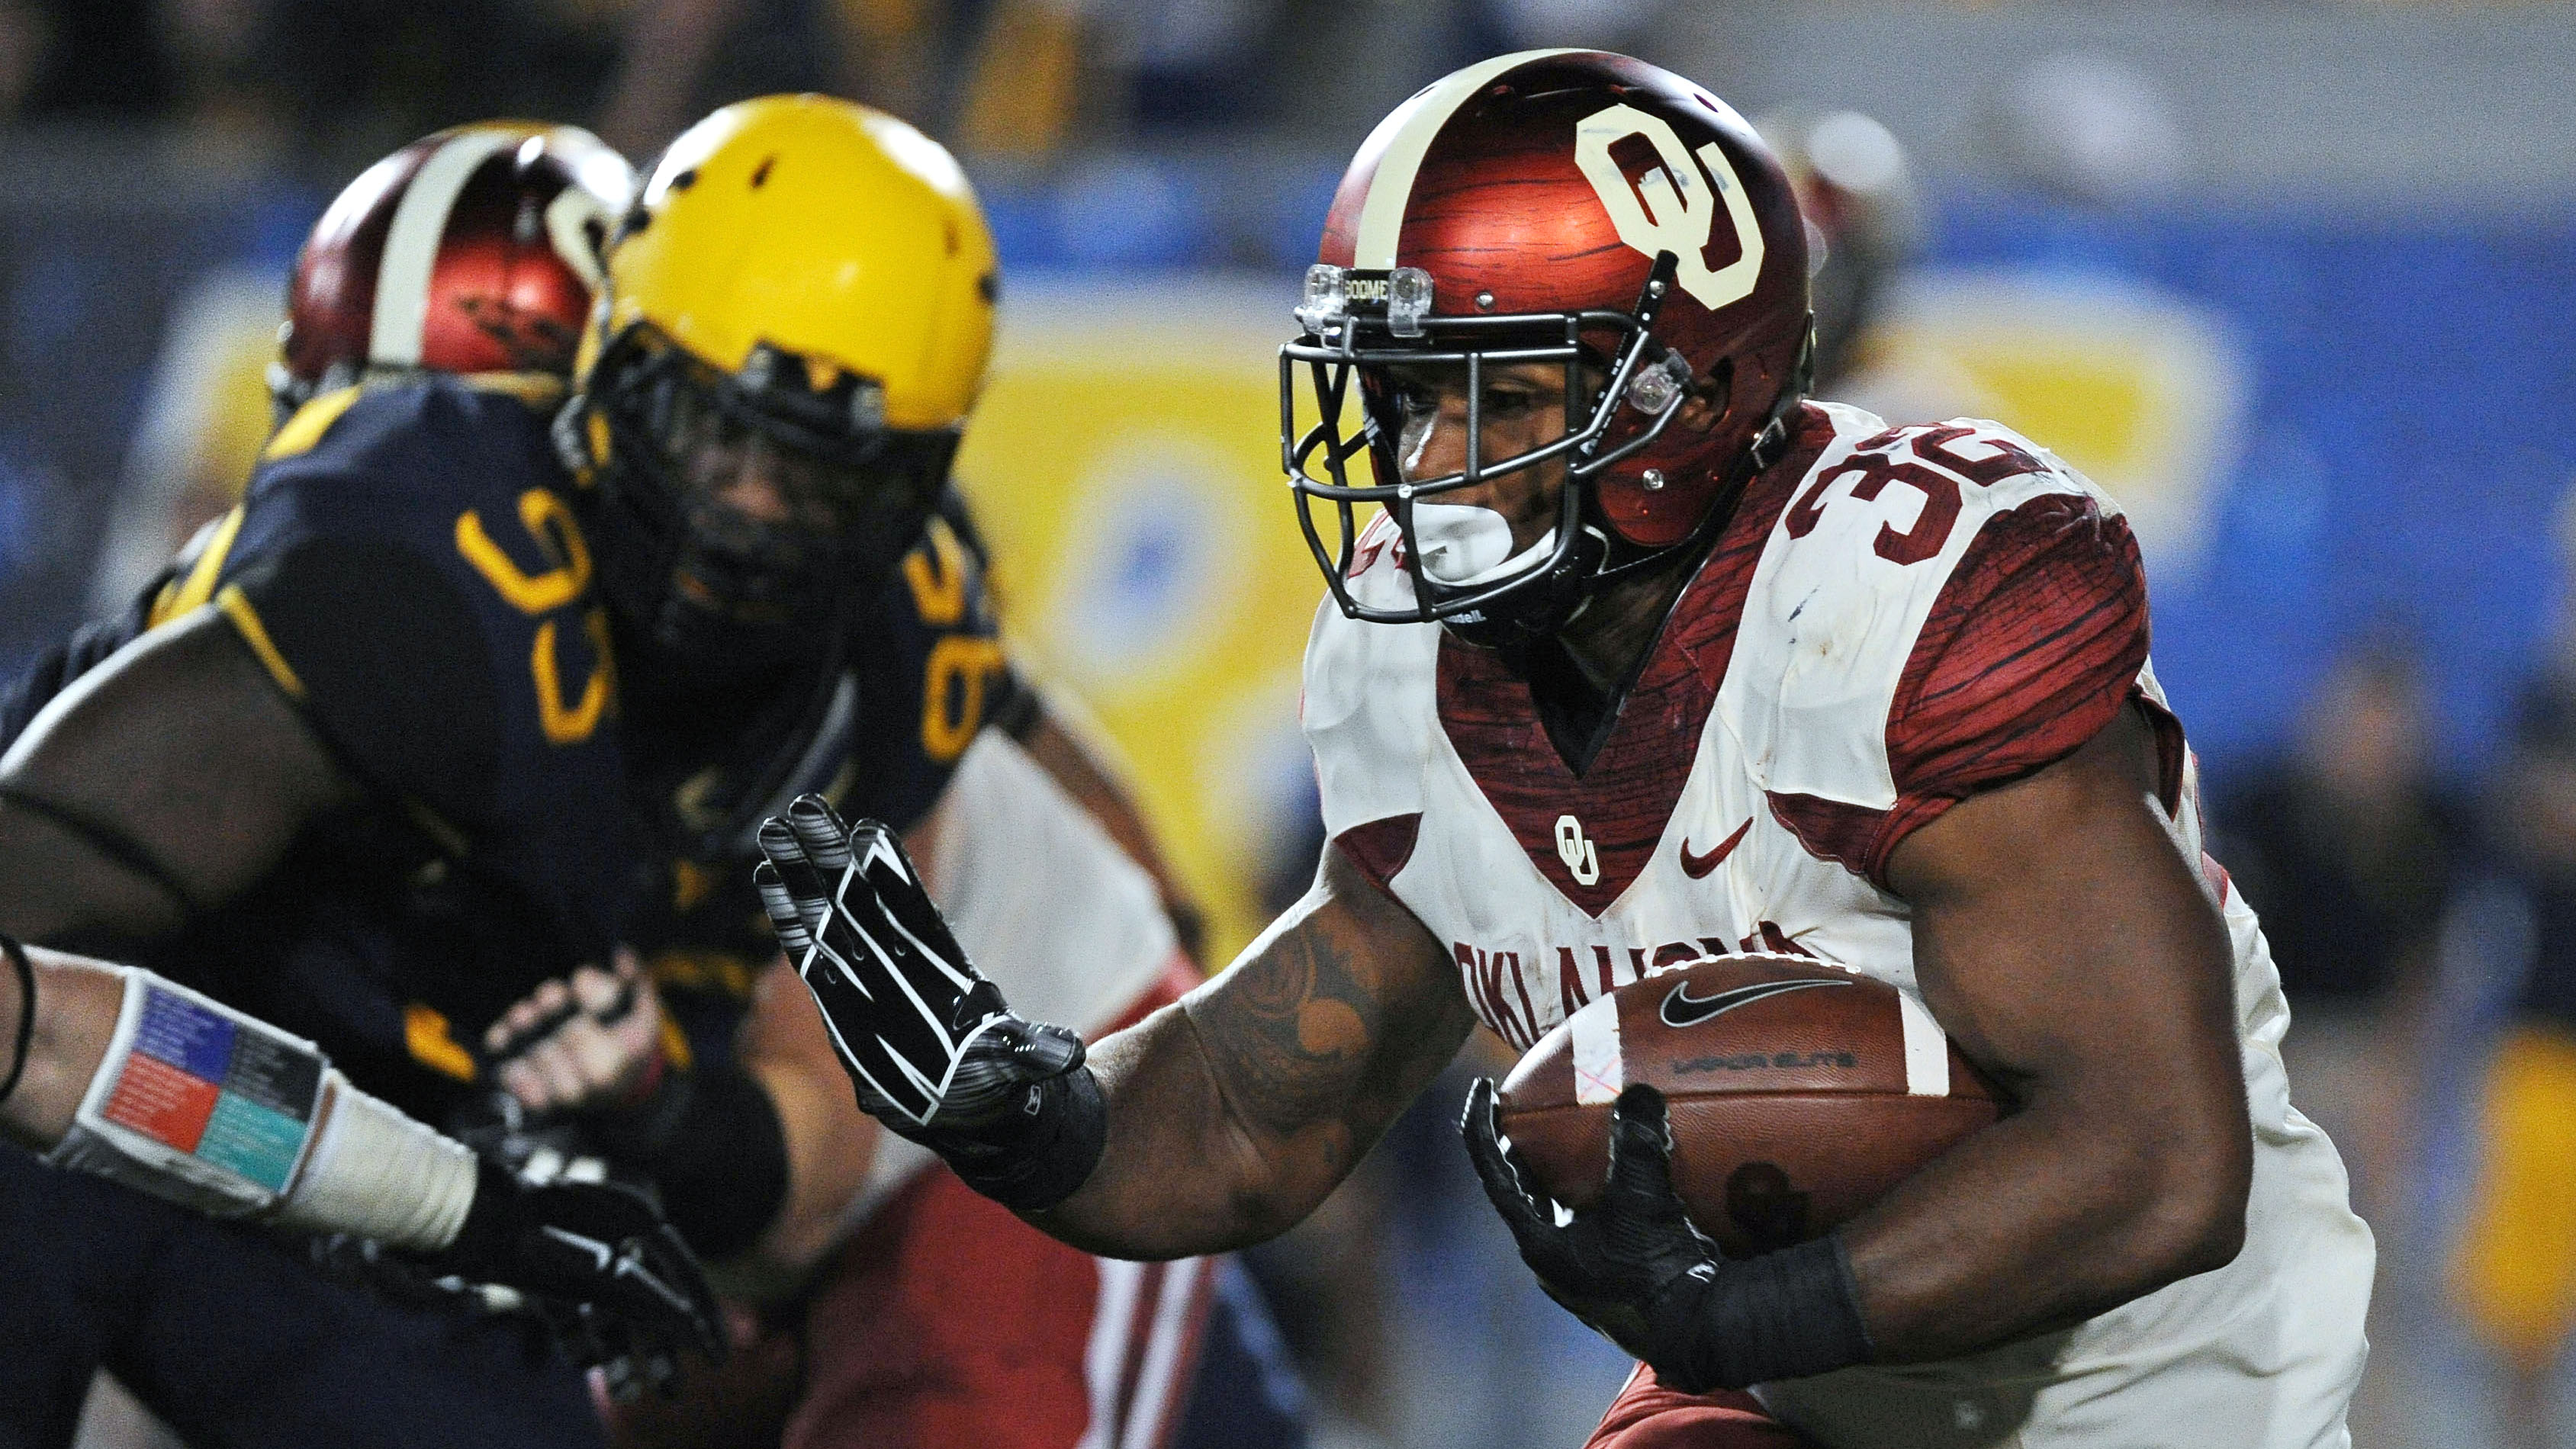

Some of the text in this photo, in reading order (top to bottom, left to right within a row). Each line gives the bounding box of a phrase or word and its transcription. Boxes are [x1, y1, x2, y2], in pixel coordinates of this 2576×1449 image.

[1574, 102, 1765, 311] OU
[1345, 279, 1389, 300] BOOME
[1785, 421, 2052, 566] 32
[1442, 609, 1487, 623] ddell
[1555, 815, 1600, 885] OU
